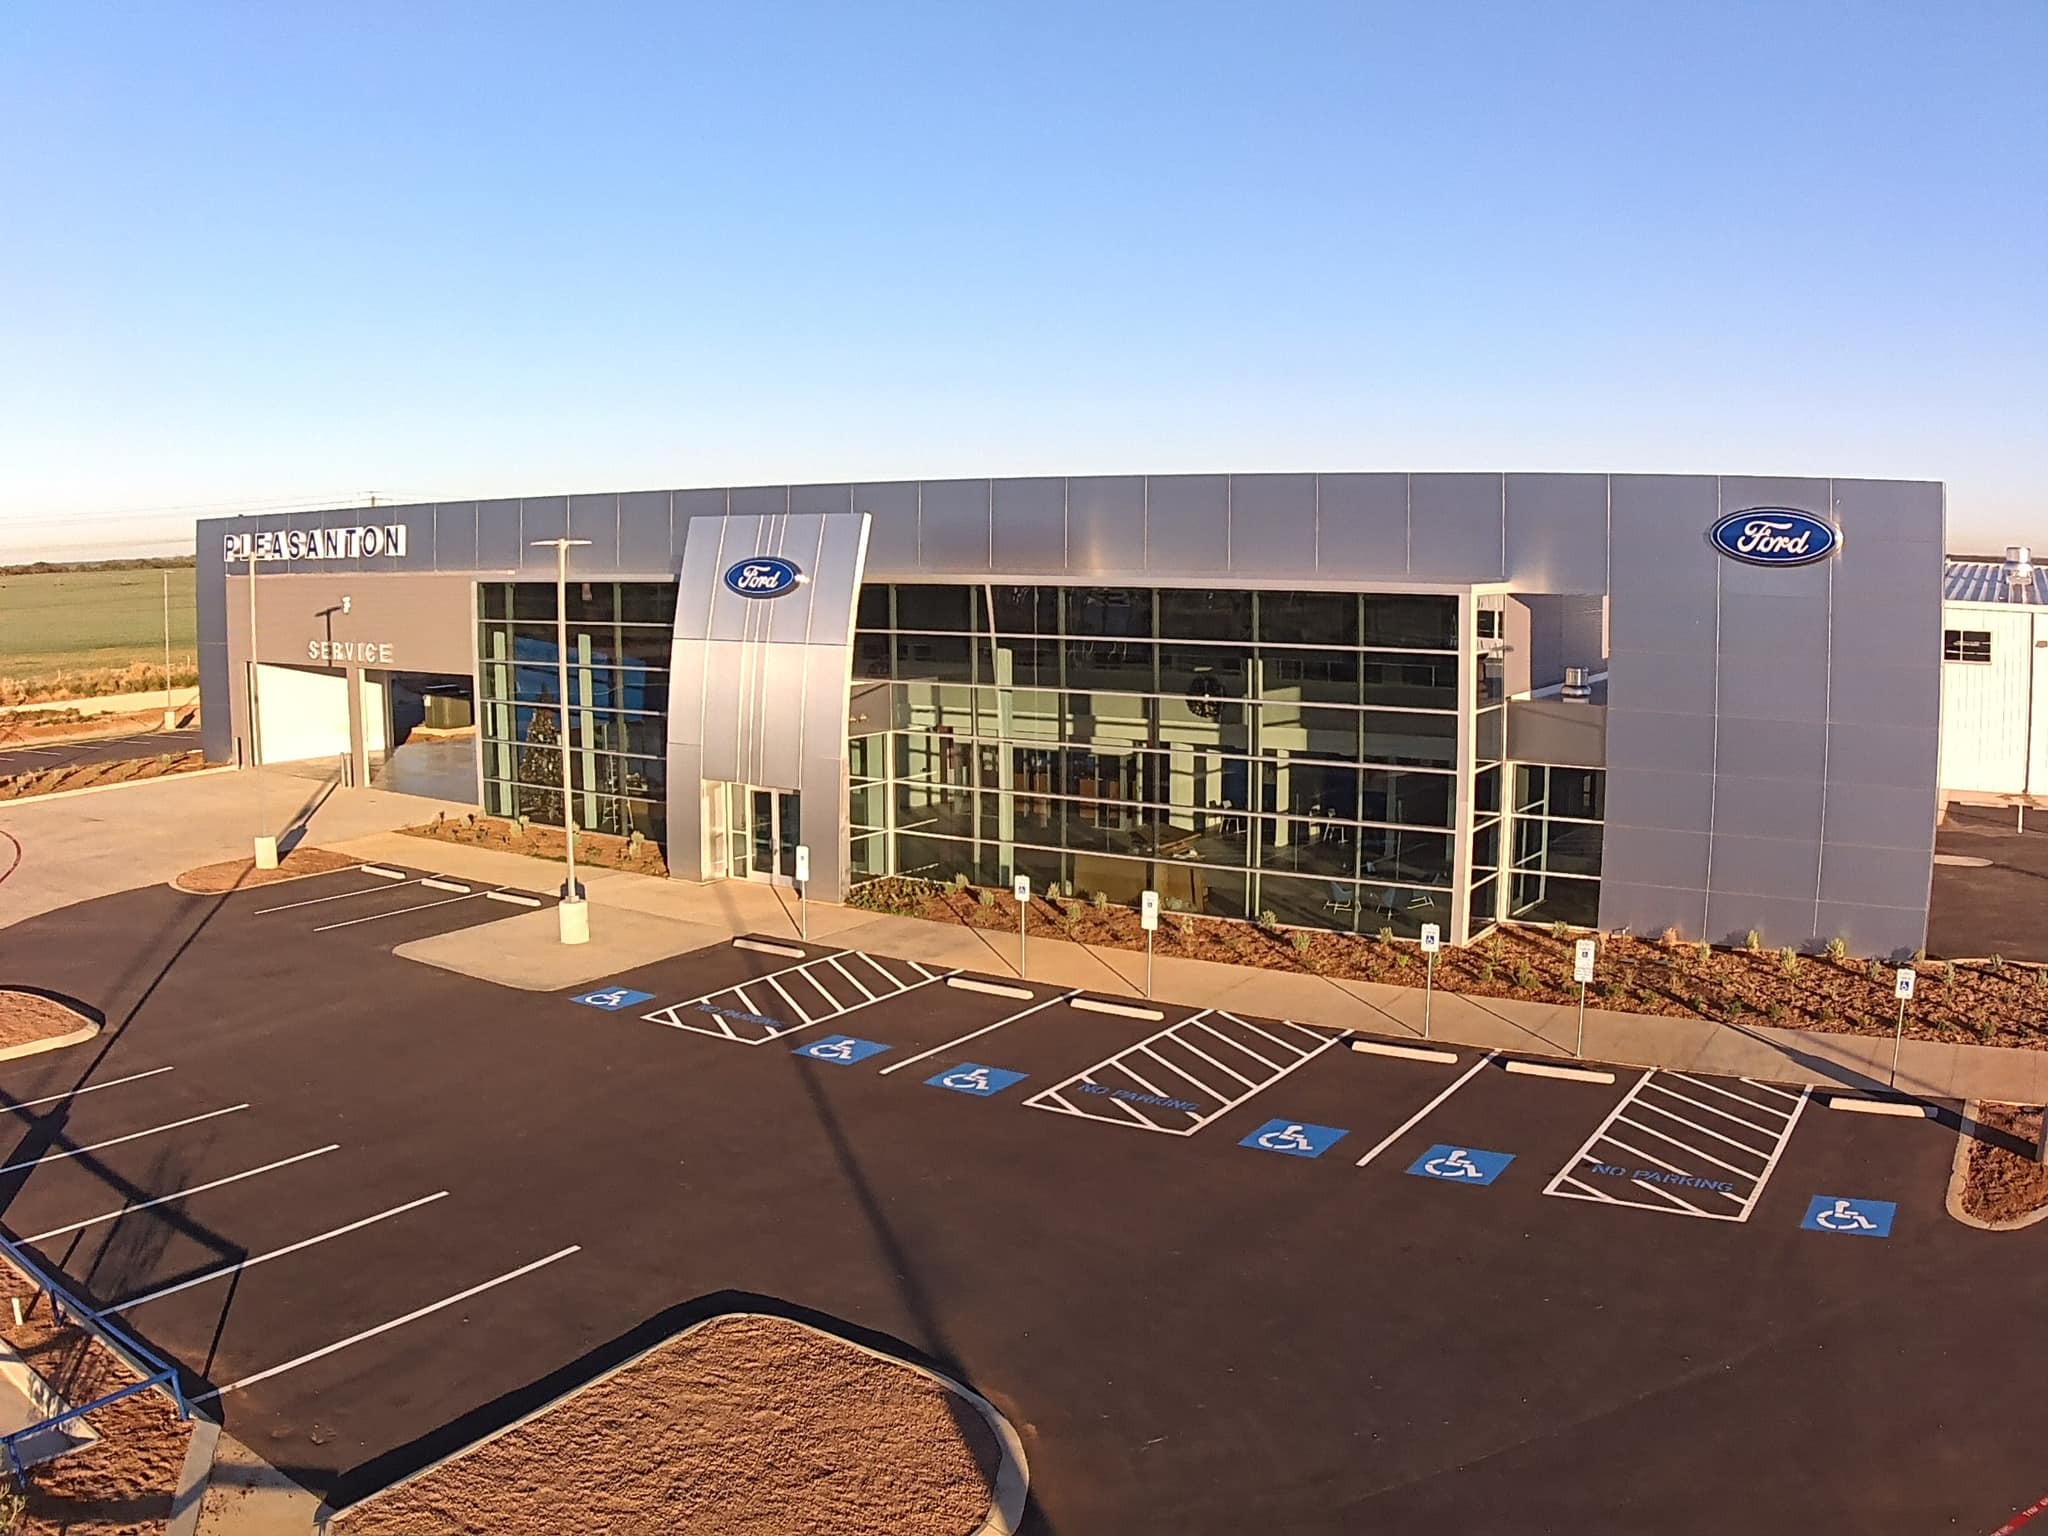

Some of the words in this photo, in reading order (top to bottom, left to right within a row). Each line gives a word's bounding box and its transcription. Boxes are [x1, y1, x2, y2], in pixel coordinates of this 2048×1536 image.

[224, 525, 406, 562] PLEASANTON
[1737, 520, 1811, 553] Ford
[738, 565, 781, 588] Ford
[308, 640, 394, 663] SERVICE
[1077, 1084, 1110, 1095] NO
[1111, 1089, 1200, 1110] PARKING
[1591, 1164, 1627, 1176] NO
[1632, 1169, 1734, 1192] PARKING
